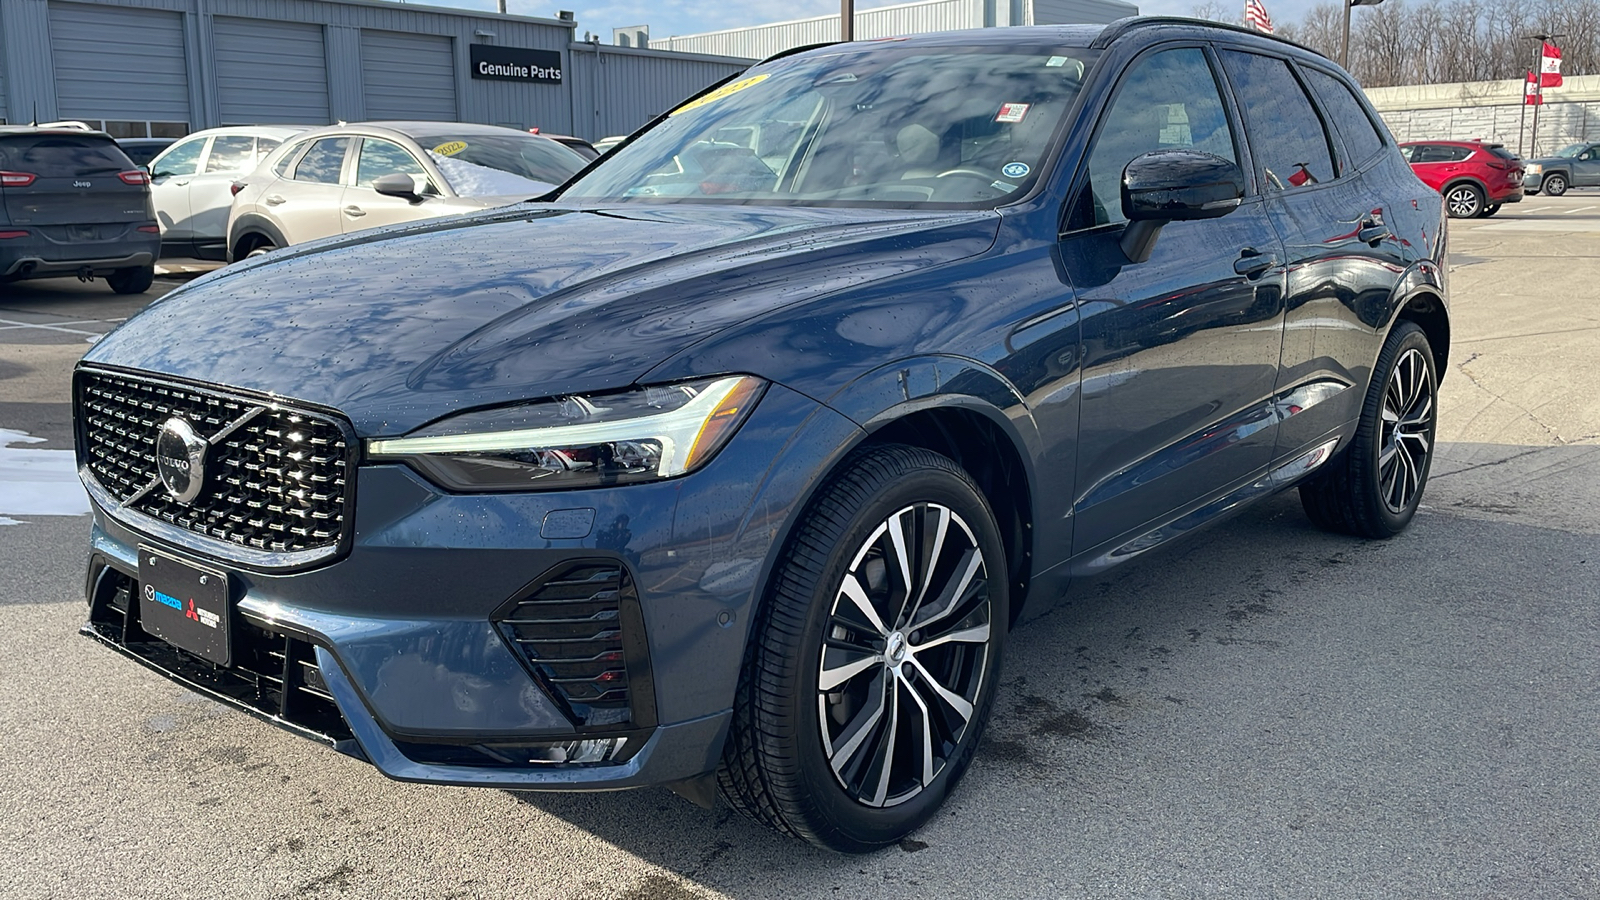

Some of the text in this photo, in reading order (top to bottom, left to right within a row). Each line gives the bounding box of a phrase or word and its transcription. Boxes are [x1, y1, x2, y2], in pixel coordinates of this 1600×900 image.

[479, 61, 561, 79] Genuine Parts
[437, 142, 463, 156] 2022
[73, 180, 91, 188] Jeep
[160, 454, 189, 470] VOLVO
